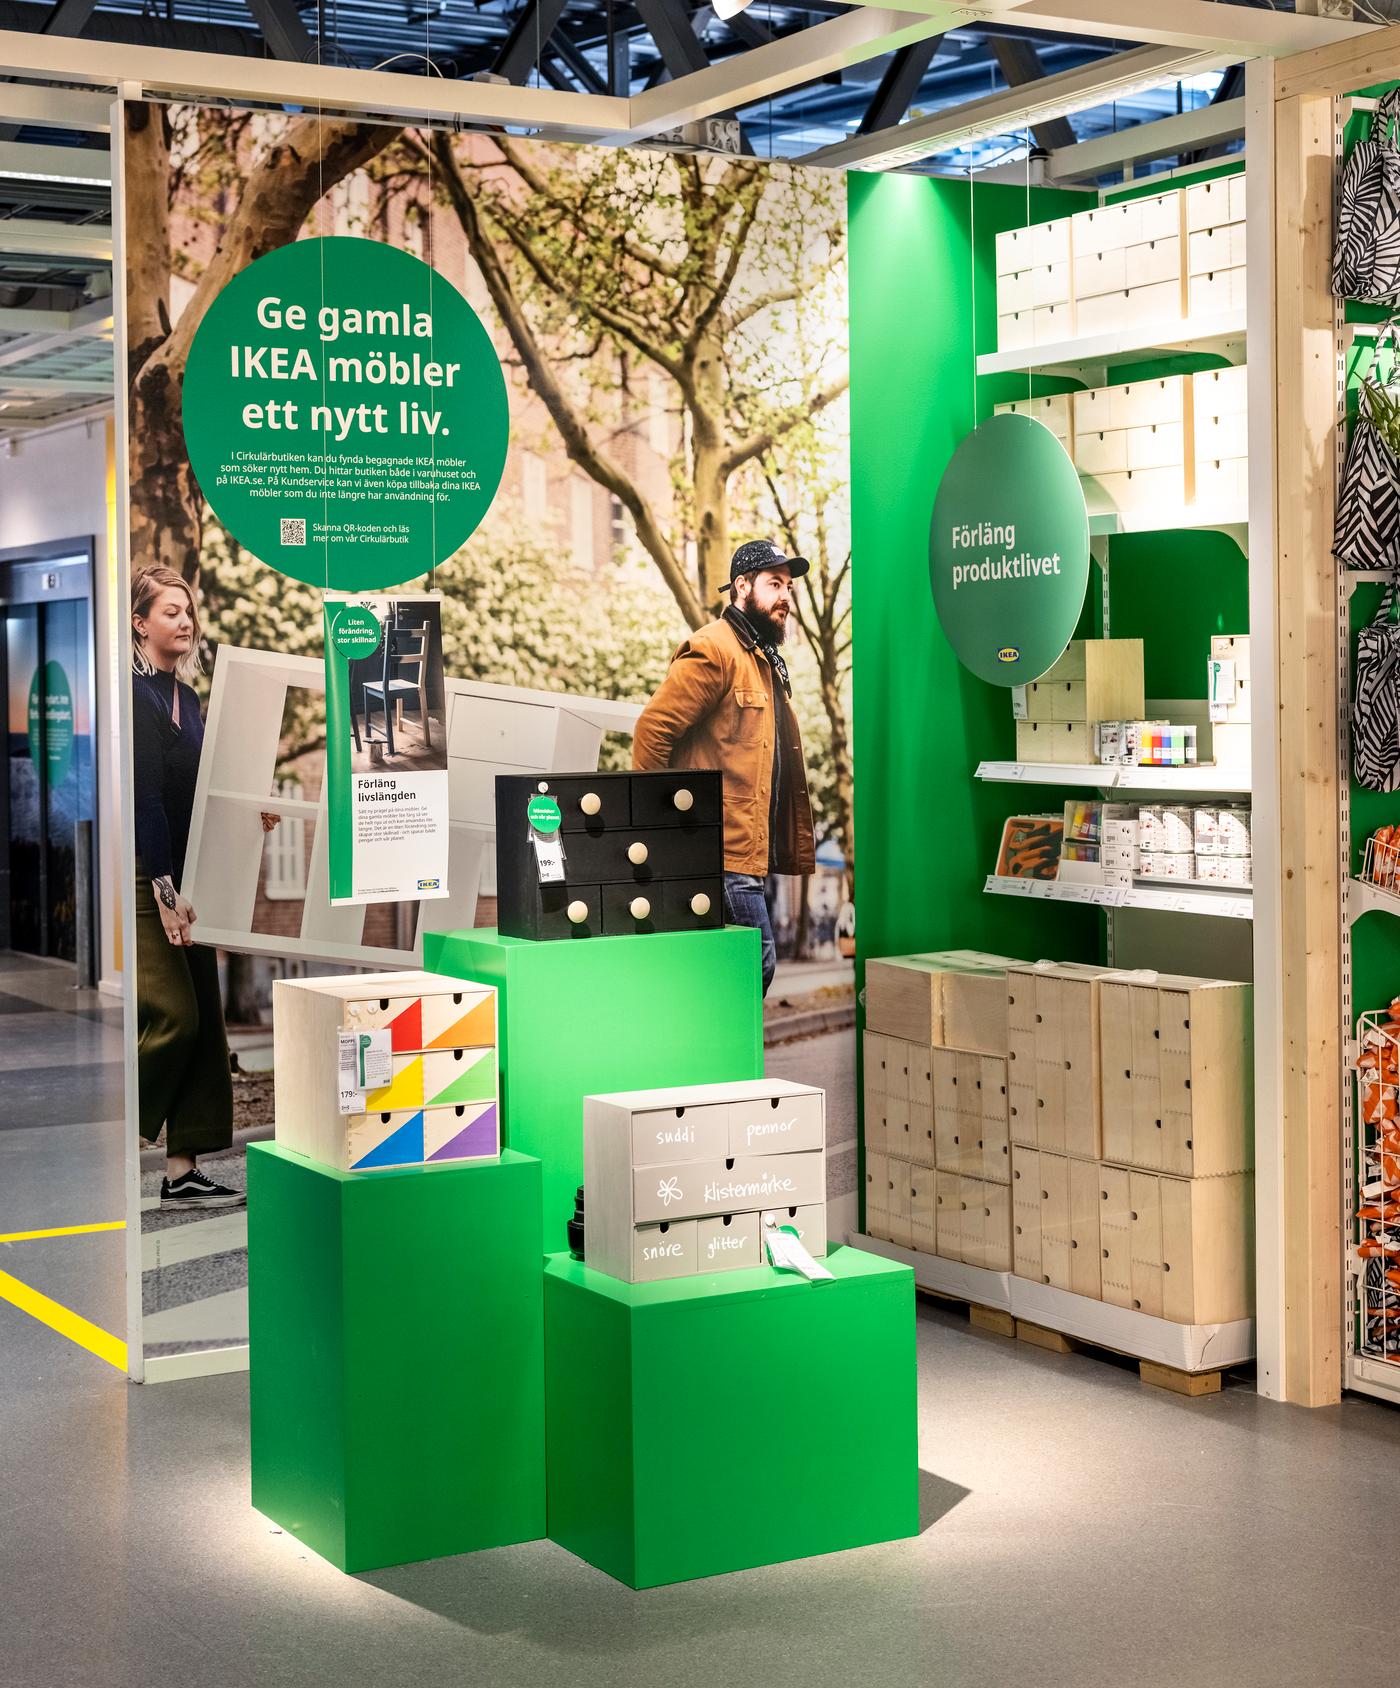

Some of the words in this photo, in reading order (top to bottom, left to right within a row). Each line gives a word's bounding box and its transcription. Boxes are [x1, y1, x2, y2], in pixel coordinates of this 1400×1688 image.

[257, 297, 306, 330] Ge
[318, 304, 433, 341] gamla
[231, 346, 317, 381] IKEA
[329, 352, 460, 387] möbler
[242, 399, 298, 430] ett
[311, 404, 388, 441] nytt
[400, 402, 450, 436] liv.
[231, 452, 234, 460] I
[236, 451, 305, 462] Cirkulärbutiken
[307, 453, 323, 463] kan
[326, 454, 337, 463] du
[339, 454, 364, 466] fynda
[366, 456, 413, 467] begagnade
[416, 457, 434, 466] IKEA
[437, 458, 466, 467] möbler
[242, 464, 267, 473] söker
[270, 465, 287, 475] nytt
[290, 465, 311, 474] hem.
[314, 466, 326, 474] Du
[329, 466, 352, 475] hittar
[355, 467, 387, 476] butiken
[389, 467, 410, 477] både
[412, 468, 415, 477] i
[416, 469, 459, 478] varuhuset
[461, 470, 476, 478] och
[216, 475, 227, 486] på
[230, 476, 265, 485] IKEA.se.
[267, 476, 279, 485] På
[281, 477, 334, 487] Kundservice
[336, 478, 352, 487] kan
[355, 479, 362, 487] vi
[364, 479, 384, 488] även
[386, 479, 407, 490] köpa
[409, 480, 439, 489] tillbaka
[442, 481, 460, 490] dina
[462, 482, 480, 490] IKEA
[250, 489, 281, 497] möbler
[306, 490, 317, 498] du
[320, 490, 335, 498] inte
[338, 490, 365, 501] längre
[368, 491, 382, 499] har
[384, 492, 434, 503] användning
[437, 493, 450, 501] för.
[312, 523, 341, 531] Skanna
[343, 524, 381, 533] QR-koden
[399, 525, 409, 533] läs
[952, 522, 1015, 550] Förläng
[345, 534, 358, 542] vår
[360, 535, 409, 543] Cirkulärbutik
[953, 553, 1061, 590] produktlivet
[358, 779, 396, 789] Förläng
[358, 791, 416, 803] livslängden
[340, 1090, 358, 1098] 179:-
[656, 1126, 695, 1145] suddi
[746, 1118, 797, 1146] pennor
[643, 1241, 684, 1261] snöre
[708, 1235, 748, 1259] glitter
